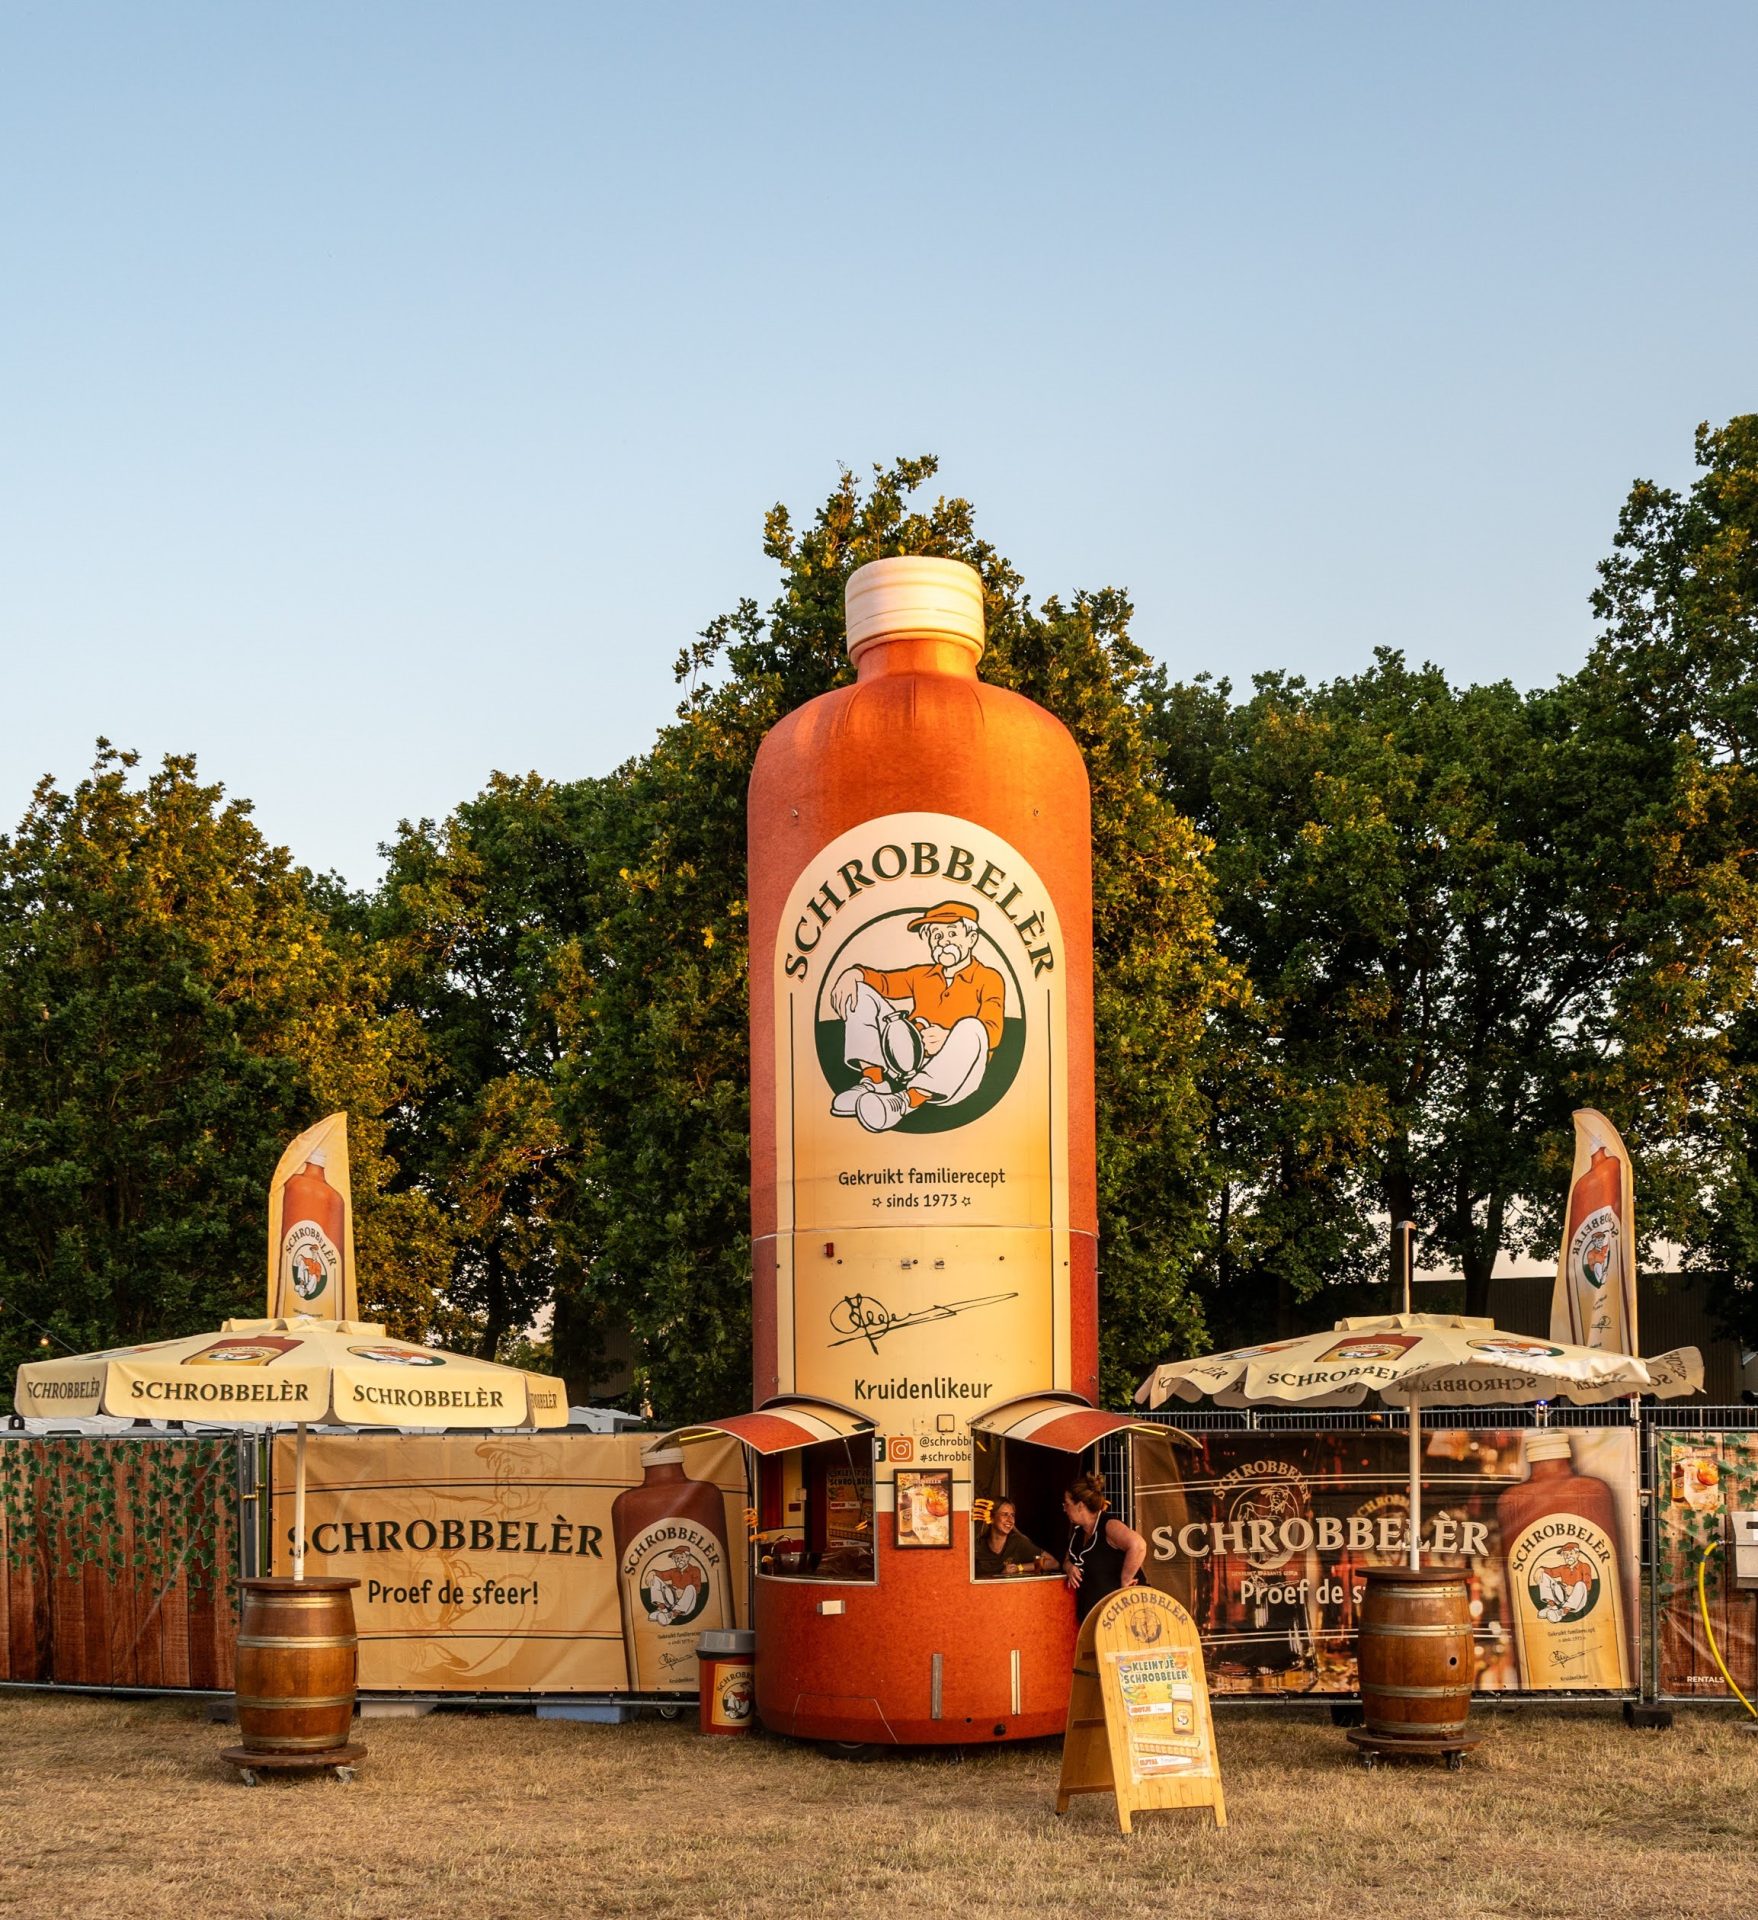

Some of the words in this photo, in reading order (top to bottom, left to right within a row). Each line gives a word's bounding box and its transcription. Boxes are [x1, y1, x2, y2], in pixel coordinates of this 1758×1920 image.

[785, 841, 1055, 982] SCHROBBELÈR
[838, 1168, 904, 1187] Gekruikt
[909, 1167, 1006, 1189] familierecept
[886, 1194, 919, 1209] sinds
[924, 1194, 958, 1208] 1973
[131, 1379, 309, 1402] SCHROBBELÈR
[353, 1384, 504, 1408] SCHROBBELÈR
[854, 1376, 993, 1400] Kruidenlikeur
[624, 1526, 720, 1576] SCHROBBELÈR
[1512, 1523, 1611, 1573] SCHROBBELÈR
[368, 1579, 433, 1604] Proef
[438, 1579, 464, 1604] de
[472, 1581, 539, 1605] sfeer!
[1240, 1579, 1311, 1605] Proef
[1315, 1579, 1344, 1605] de
[1102, 1592, 1188, 1631] SCHROBBELÈR
[1686, 1675, 1725, 1684] RENTALS
